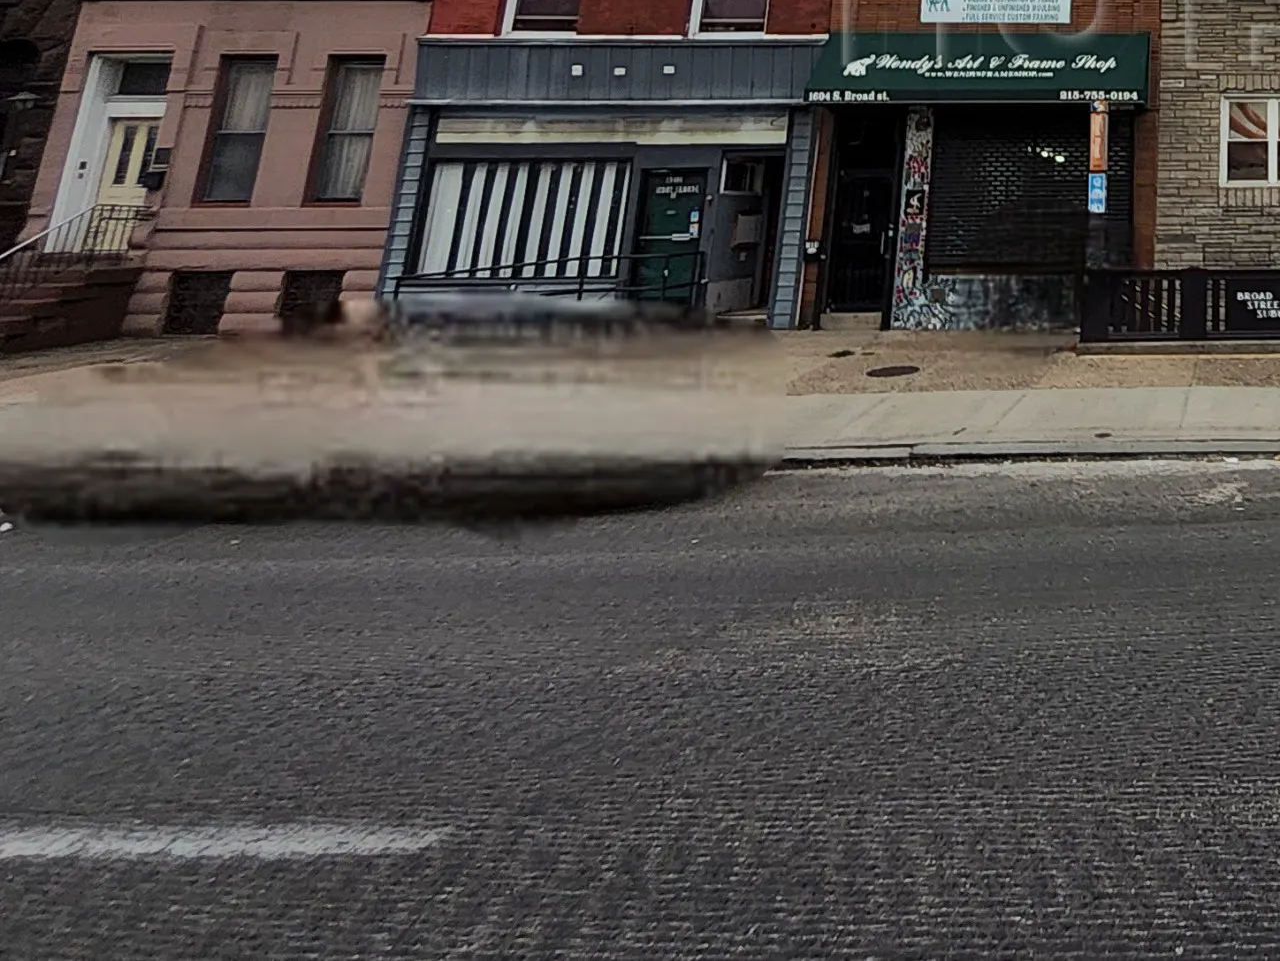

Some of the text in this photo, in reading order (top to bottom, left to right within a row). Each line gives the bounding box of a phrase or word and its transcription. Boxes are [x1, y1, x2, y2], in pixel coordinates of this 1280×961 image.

[875, 54, 942, 74] Wendy's
[947, 54, 984, 70] Art
[1007, 54, 1065, 70] Frame
[1071, 54, 1117, 73] Shop
[809, 91, 831, 101] 1604
[844, 91, 874, 101] Broad
[1236, 291, 1273, 301] BROAD
